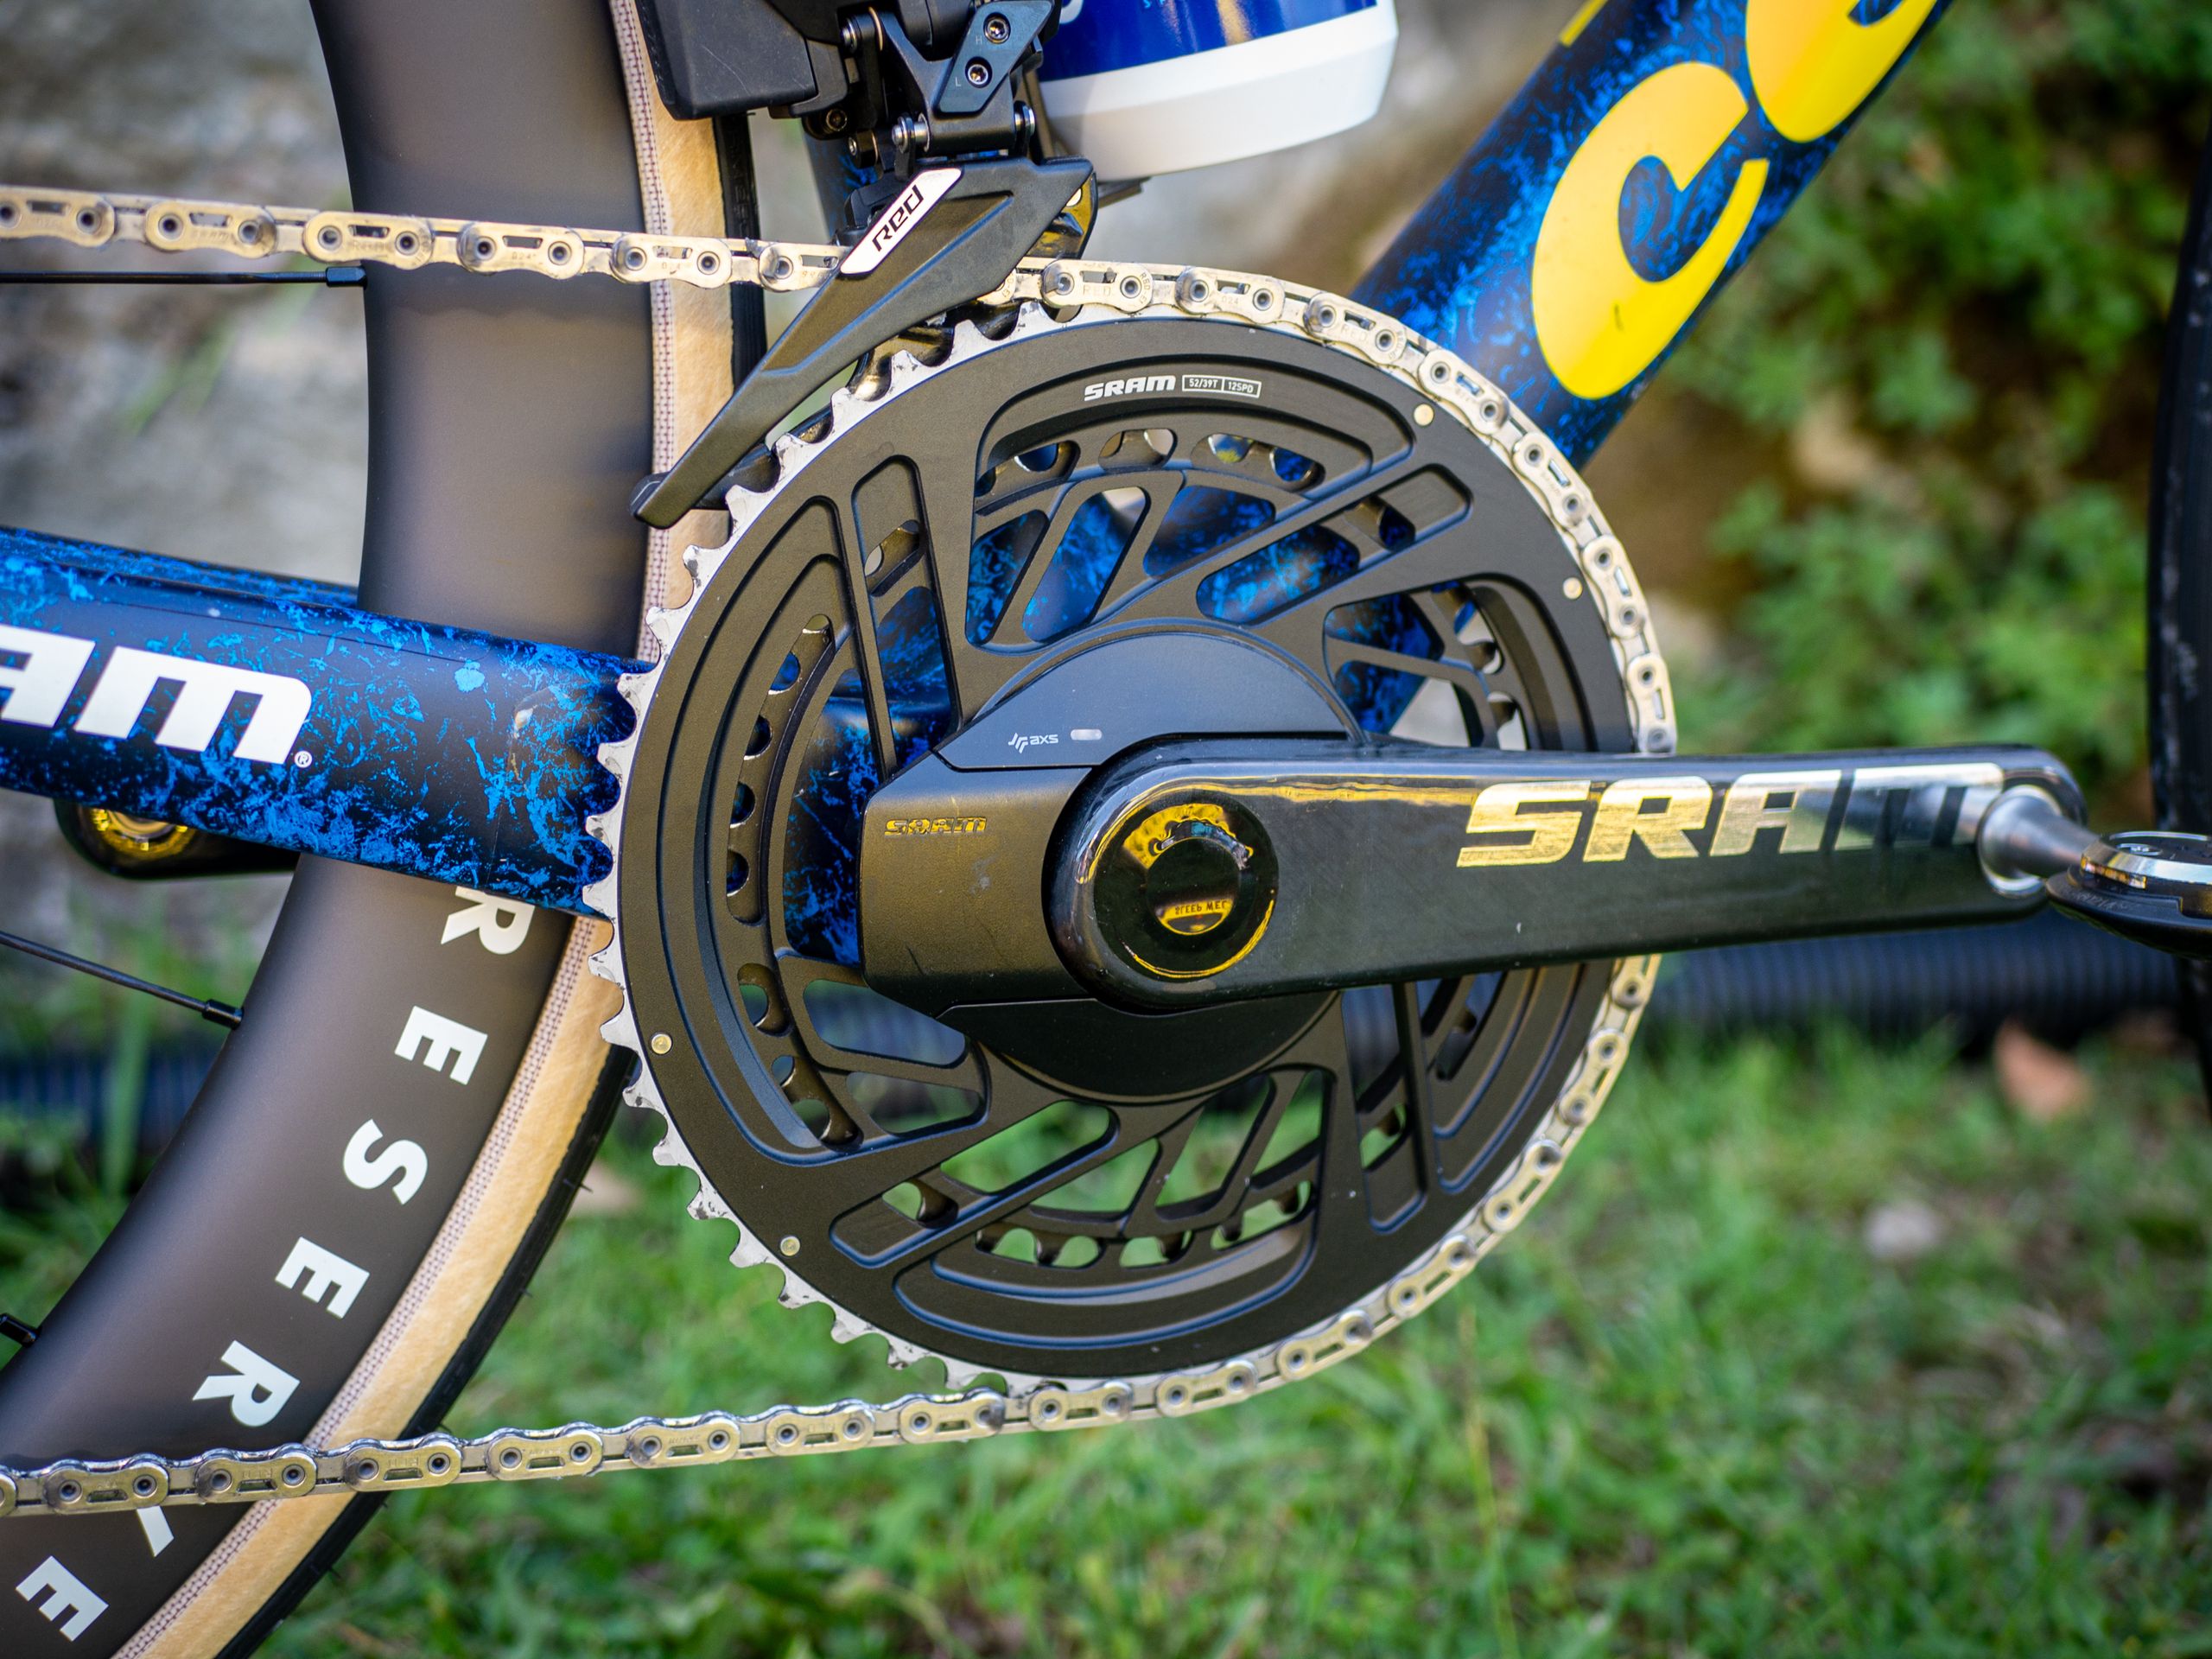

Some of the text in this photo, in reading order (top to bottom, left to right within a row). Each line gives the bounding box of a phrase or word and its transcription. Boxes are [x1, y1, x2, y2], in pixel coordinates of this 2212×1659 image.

[976, 35, 982, 45] H
[955, 77, 962, 86] L
[1084, 375, 1176, 401] SRAM
[1189, 378, 1218, 389] 52/39T
[1456, 763, 2003, 868] SRAM
[884, 816, 987, 837] SRAM
